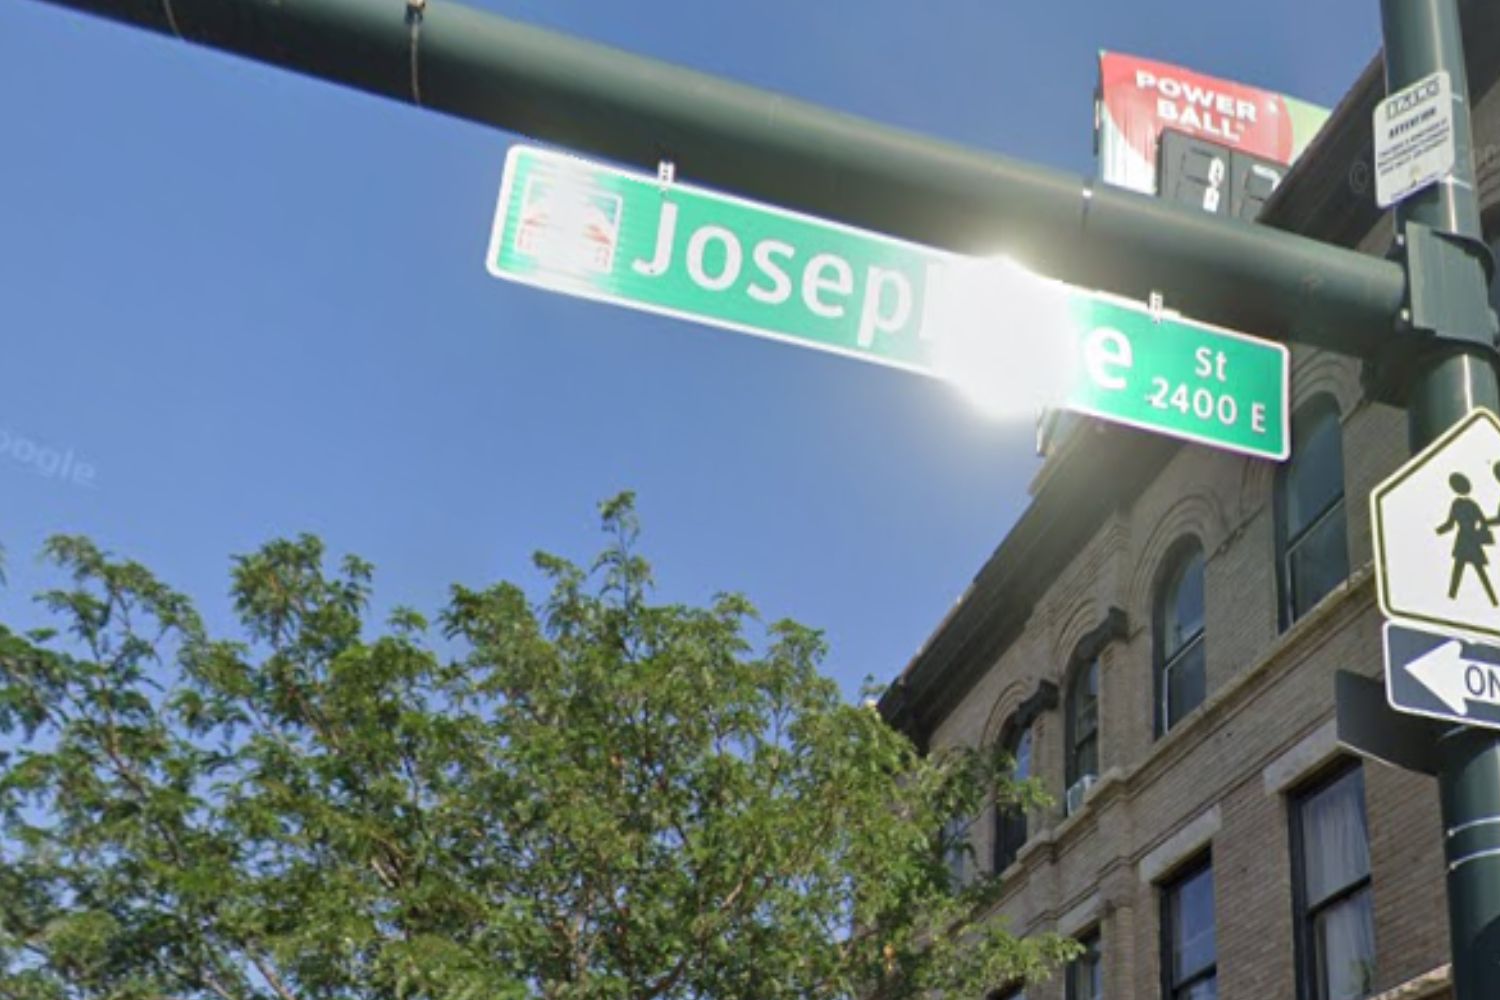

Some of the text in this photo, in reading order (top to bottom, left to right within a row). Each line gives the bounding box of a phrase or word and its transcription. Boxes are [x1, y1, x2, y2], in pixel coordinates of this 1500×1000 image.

[1136, 69, 1256, 122] POWER
[1157, 97, 1240, 142] BALL
[632, 200, 1133, 391] Josepe
[1195, 345, 1227, 381] St
[1148, 376, 1266, 434] 2400 E
